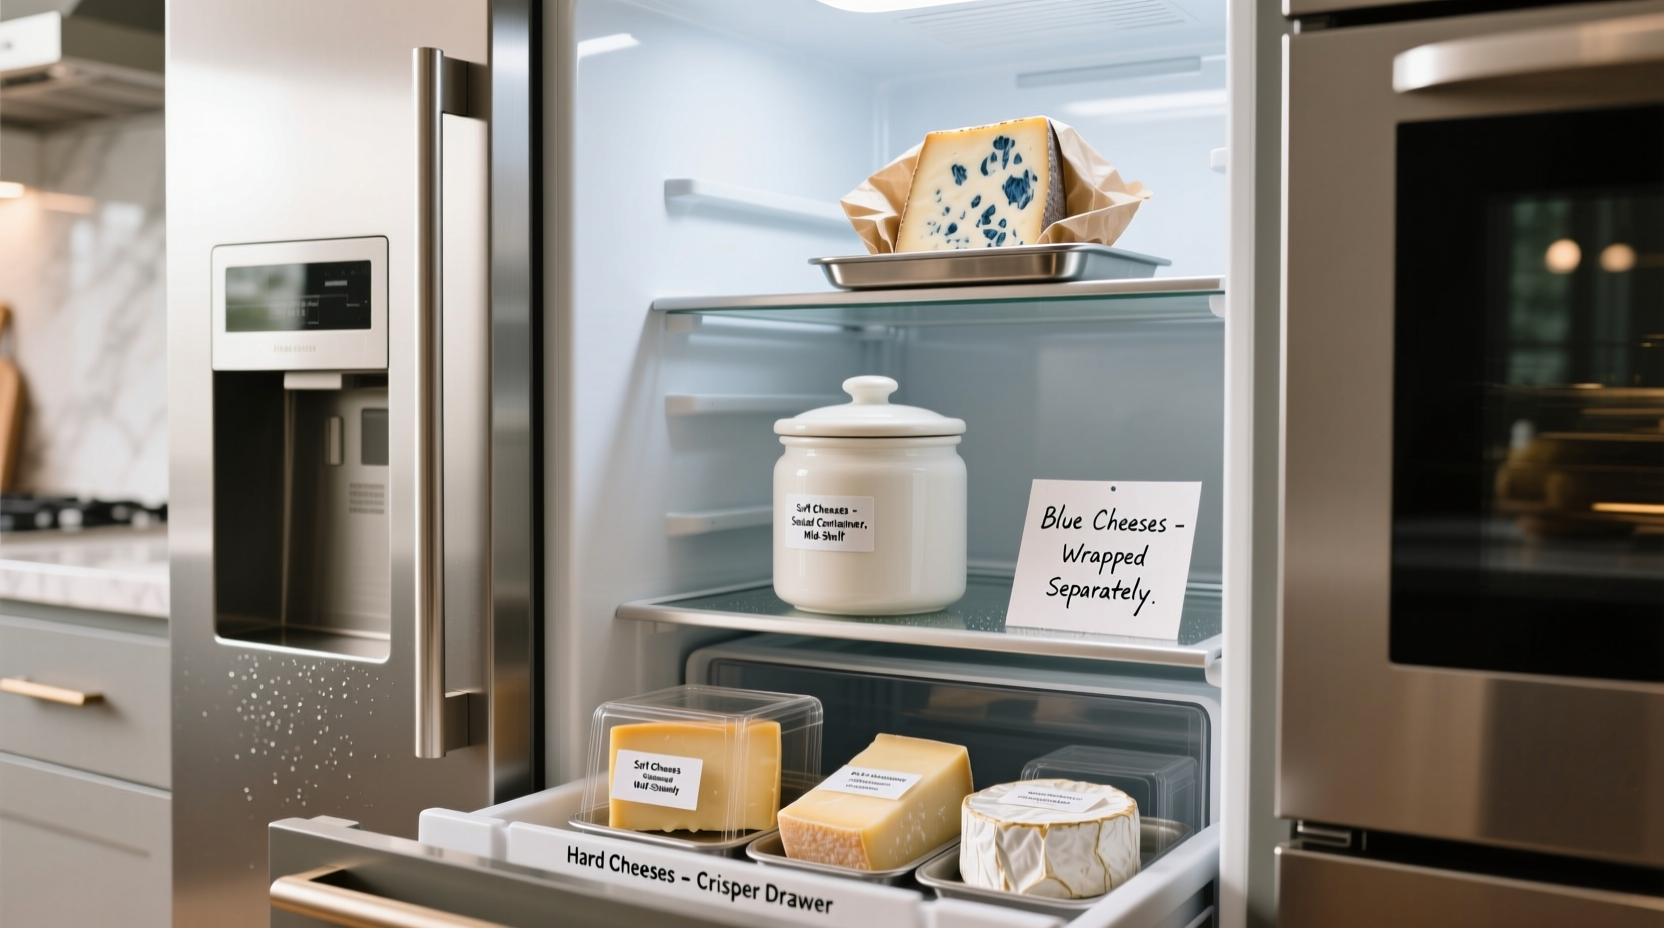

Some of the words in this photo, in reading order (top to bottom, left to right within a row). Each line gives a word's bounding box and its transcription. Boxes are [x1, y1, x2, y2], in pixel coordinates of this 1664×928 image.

[1040, 504, 1083, 530] Blue
[1093, 507, 1167, 533] Cheeses
[1062, 543, 1149, 575] Wrapped
[1045, 576, 1156, 617] Separately.
[567, 845, 605, 869] Hard
[608, 853, 676, 884] Cheeses
[696, 871, 760, 902] Crisper
[765, 883, 834, 915] Drawer
